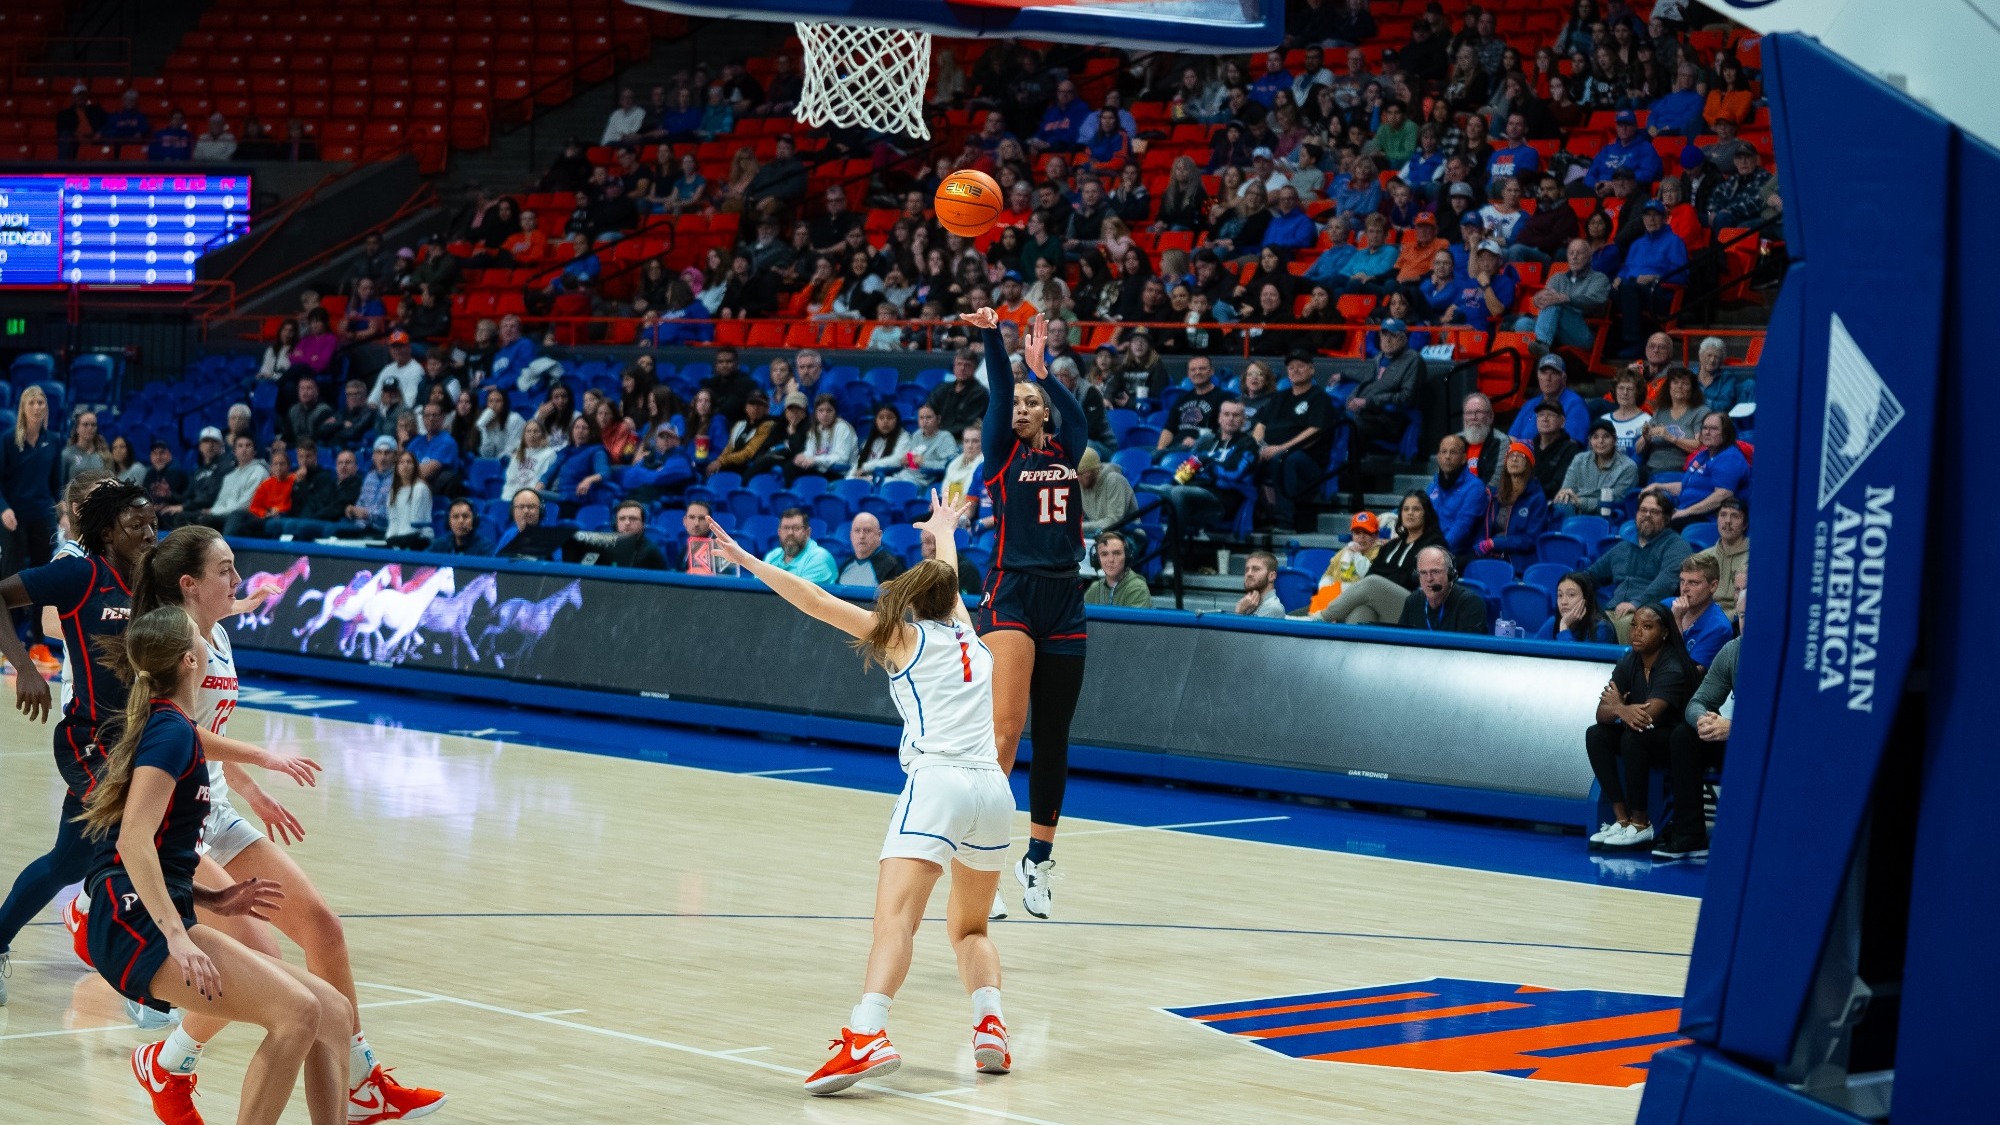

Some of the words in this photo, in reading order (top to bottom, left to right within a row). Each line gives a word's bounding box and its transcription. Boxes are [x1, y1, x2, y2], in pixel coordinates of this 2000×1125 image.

[71, 195, 83, 208] 2
[110, 195, 117, 208] 1
[148, 195, 155, 208] 1
[184, 195, 196, 208] 0
[222, 195, 235, 208] 0
[71, 214, 83, 227] 0
[108, 214, 119, 227] 0
[146, 214, 158, 227] 0
[183, 214, 196, 227] 0
[71, 231, 83, 246] 5
[110, 231, 116, 246] 1
[146, 231, 158, 246] 0
[183, 231, 196, 246] 0
[71, 250, 81, 264] 7
[109, 250, 116, 264] 1
[145, 250, 157, 264] 0
[183, 250, 195, 264] 0
[70, 269, 82, 283] 0
[109, 269, 116, 283] 1
[145, 269, 157, 283] 0
[1038, 487, 1070, 523] 15
[1811, 521, 1829, 598] CREDIT
[1818, 501, 1863, 693] AMERICA
[1847, 484, 1896, 713] MOUNTAIN
[1804, 604, 1821, 671] UNION
[959, 641, 972, 683] 1
